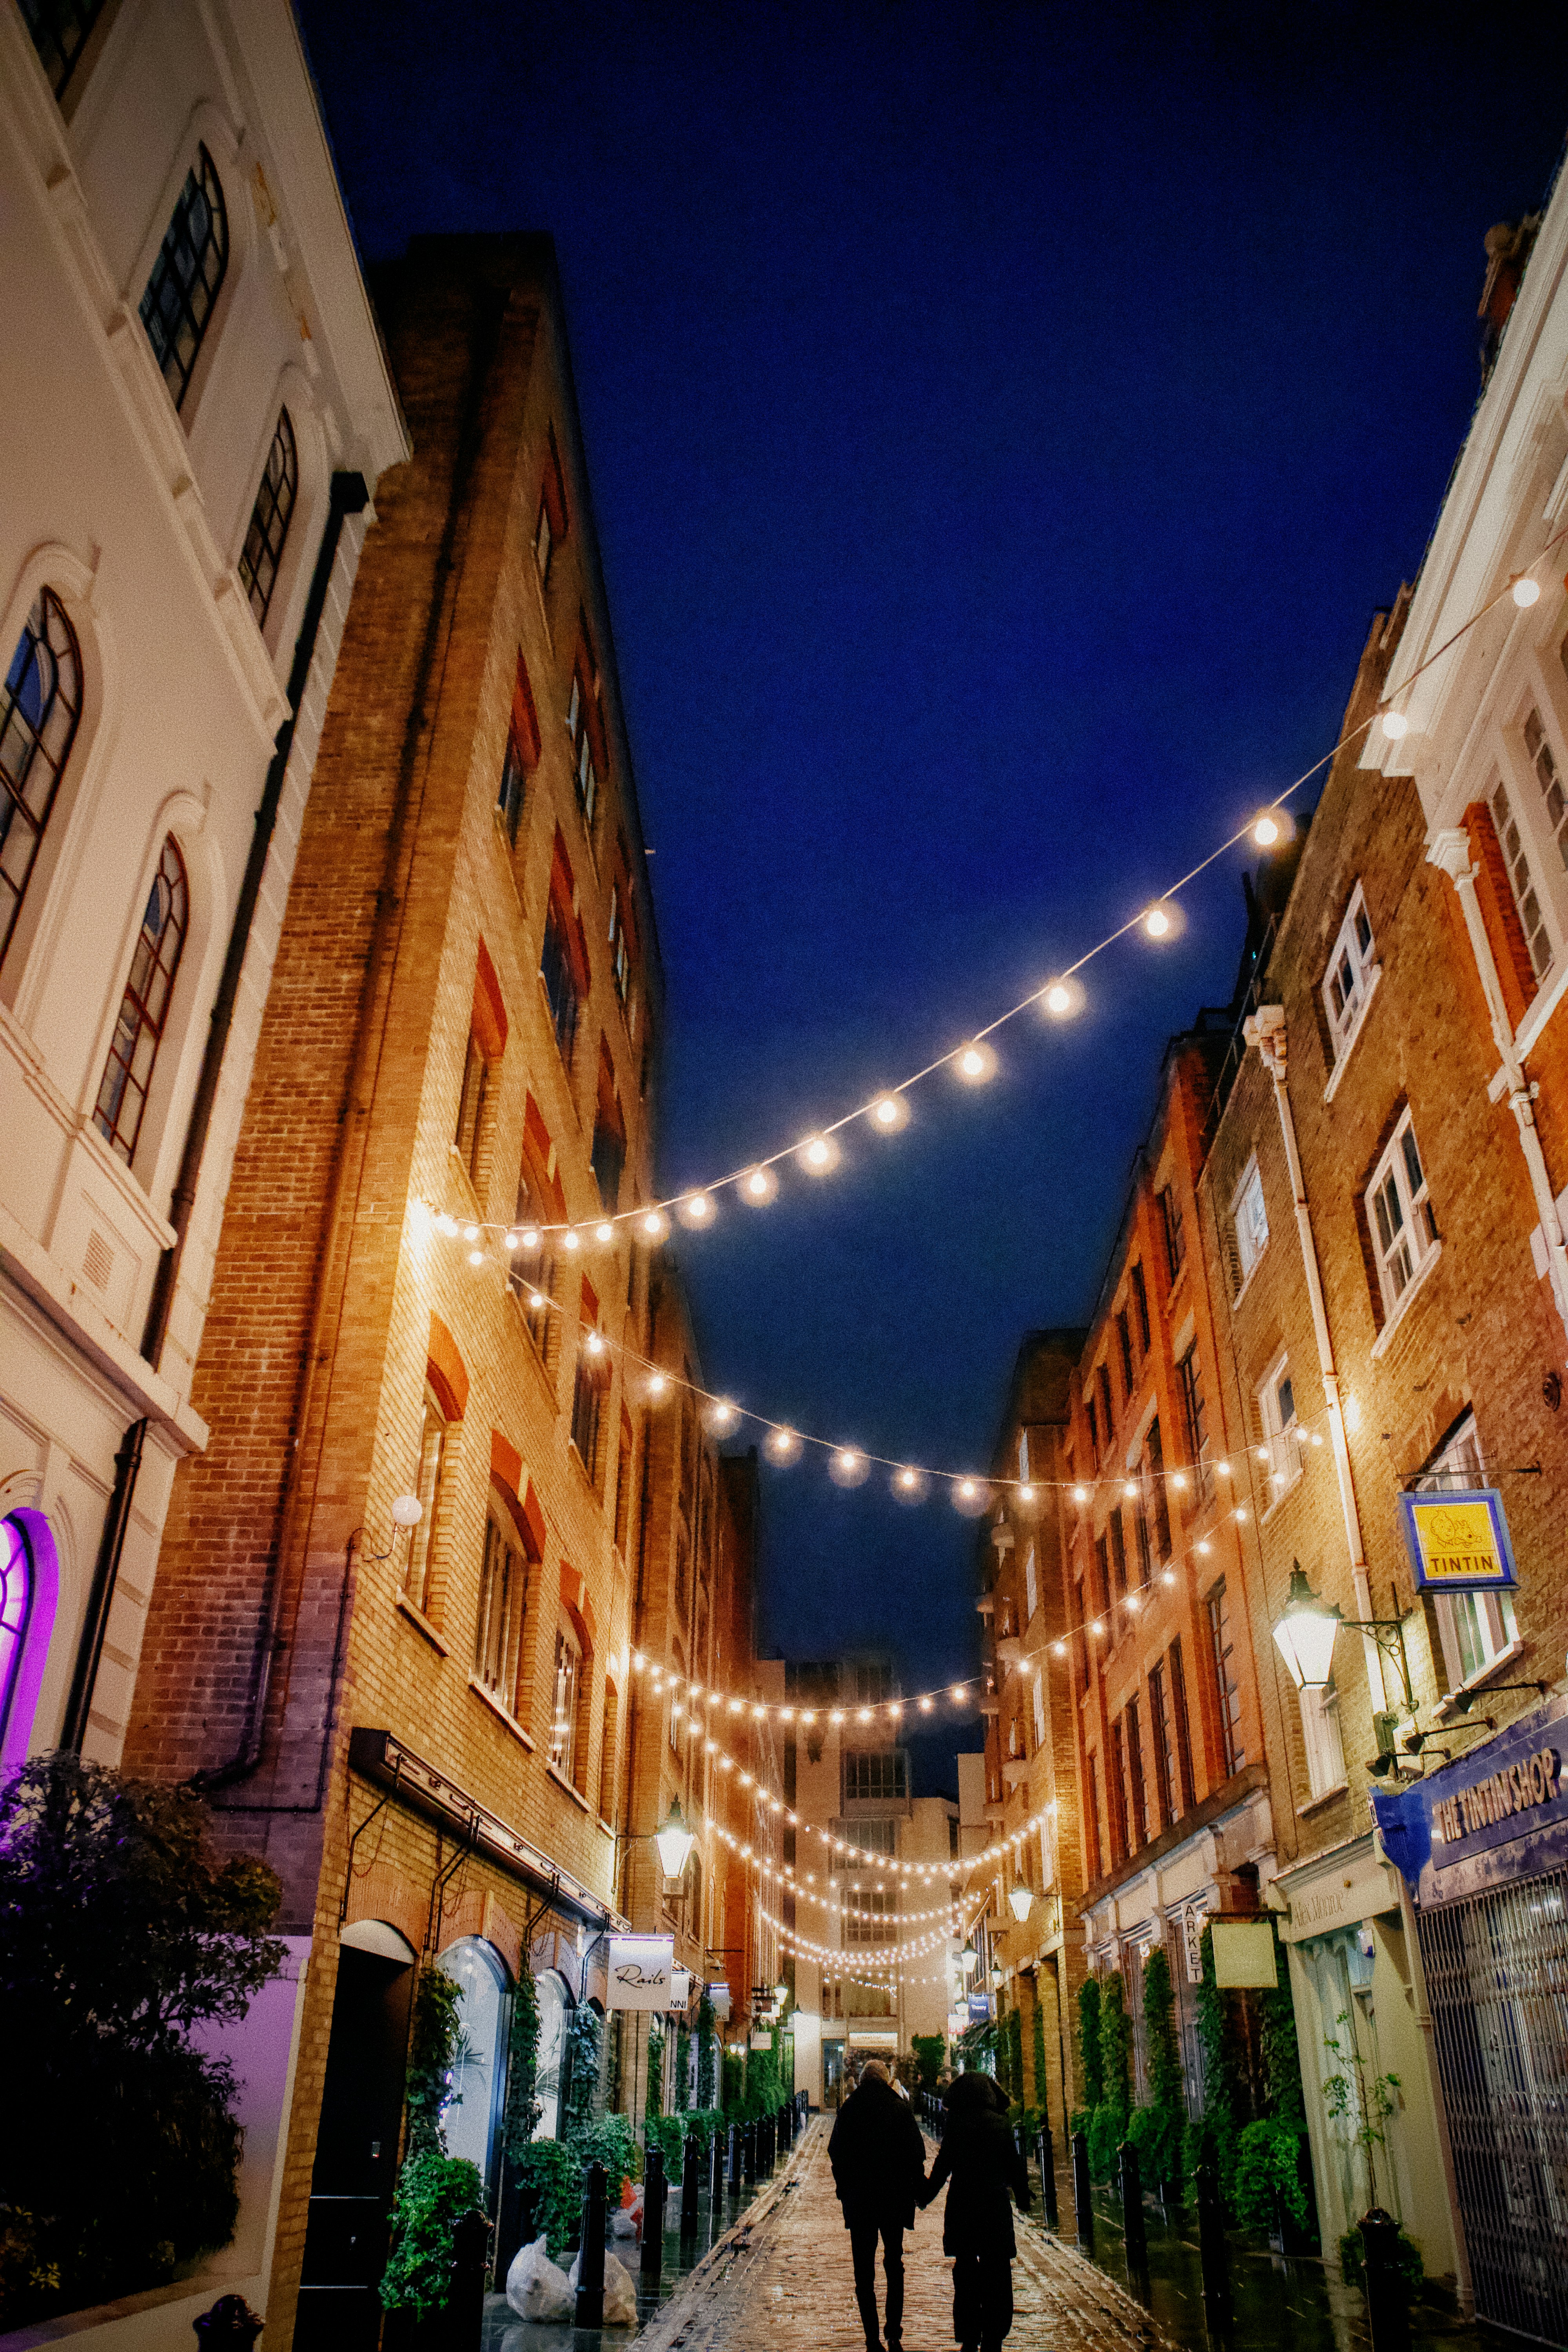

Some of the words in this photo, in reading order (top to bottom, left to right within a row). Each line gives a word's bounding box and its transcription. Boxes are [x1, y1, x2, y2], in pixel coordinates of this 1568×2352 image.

[1430, 1555, 1493, 1572] TINTIN
[1432, 1795, 1462, 1844] THE
[1457, 1770, 1513, 1834] TINTIN
[1509, 1748, 1558, 1812] SHOP
[1294, 1902, 1311, 1929] Alex
[1312, 1892, 1344, 1921] Monroe
[1185, 1905, 1200, 1981] ARKET
[614, 1964, 665, 1988] Rails
